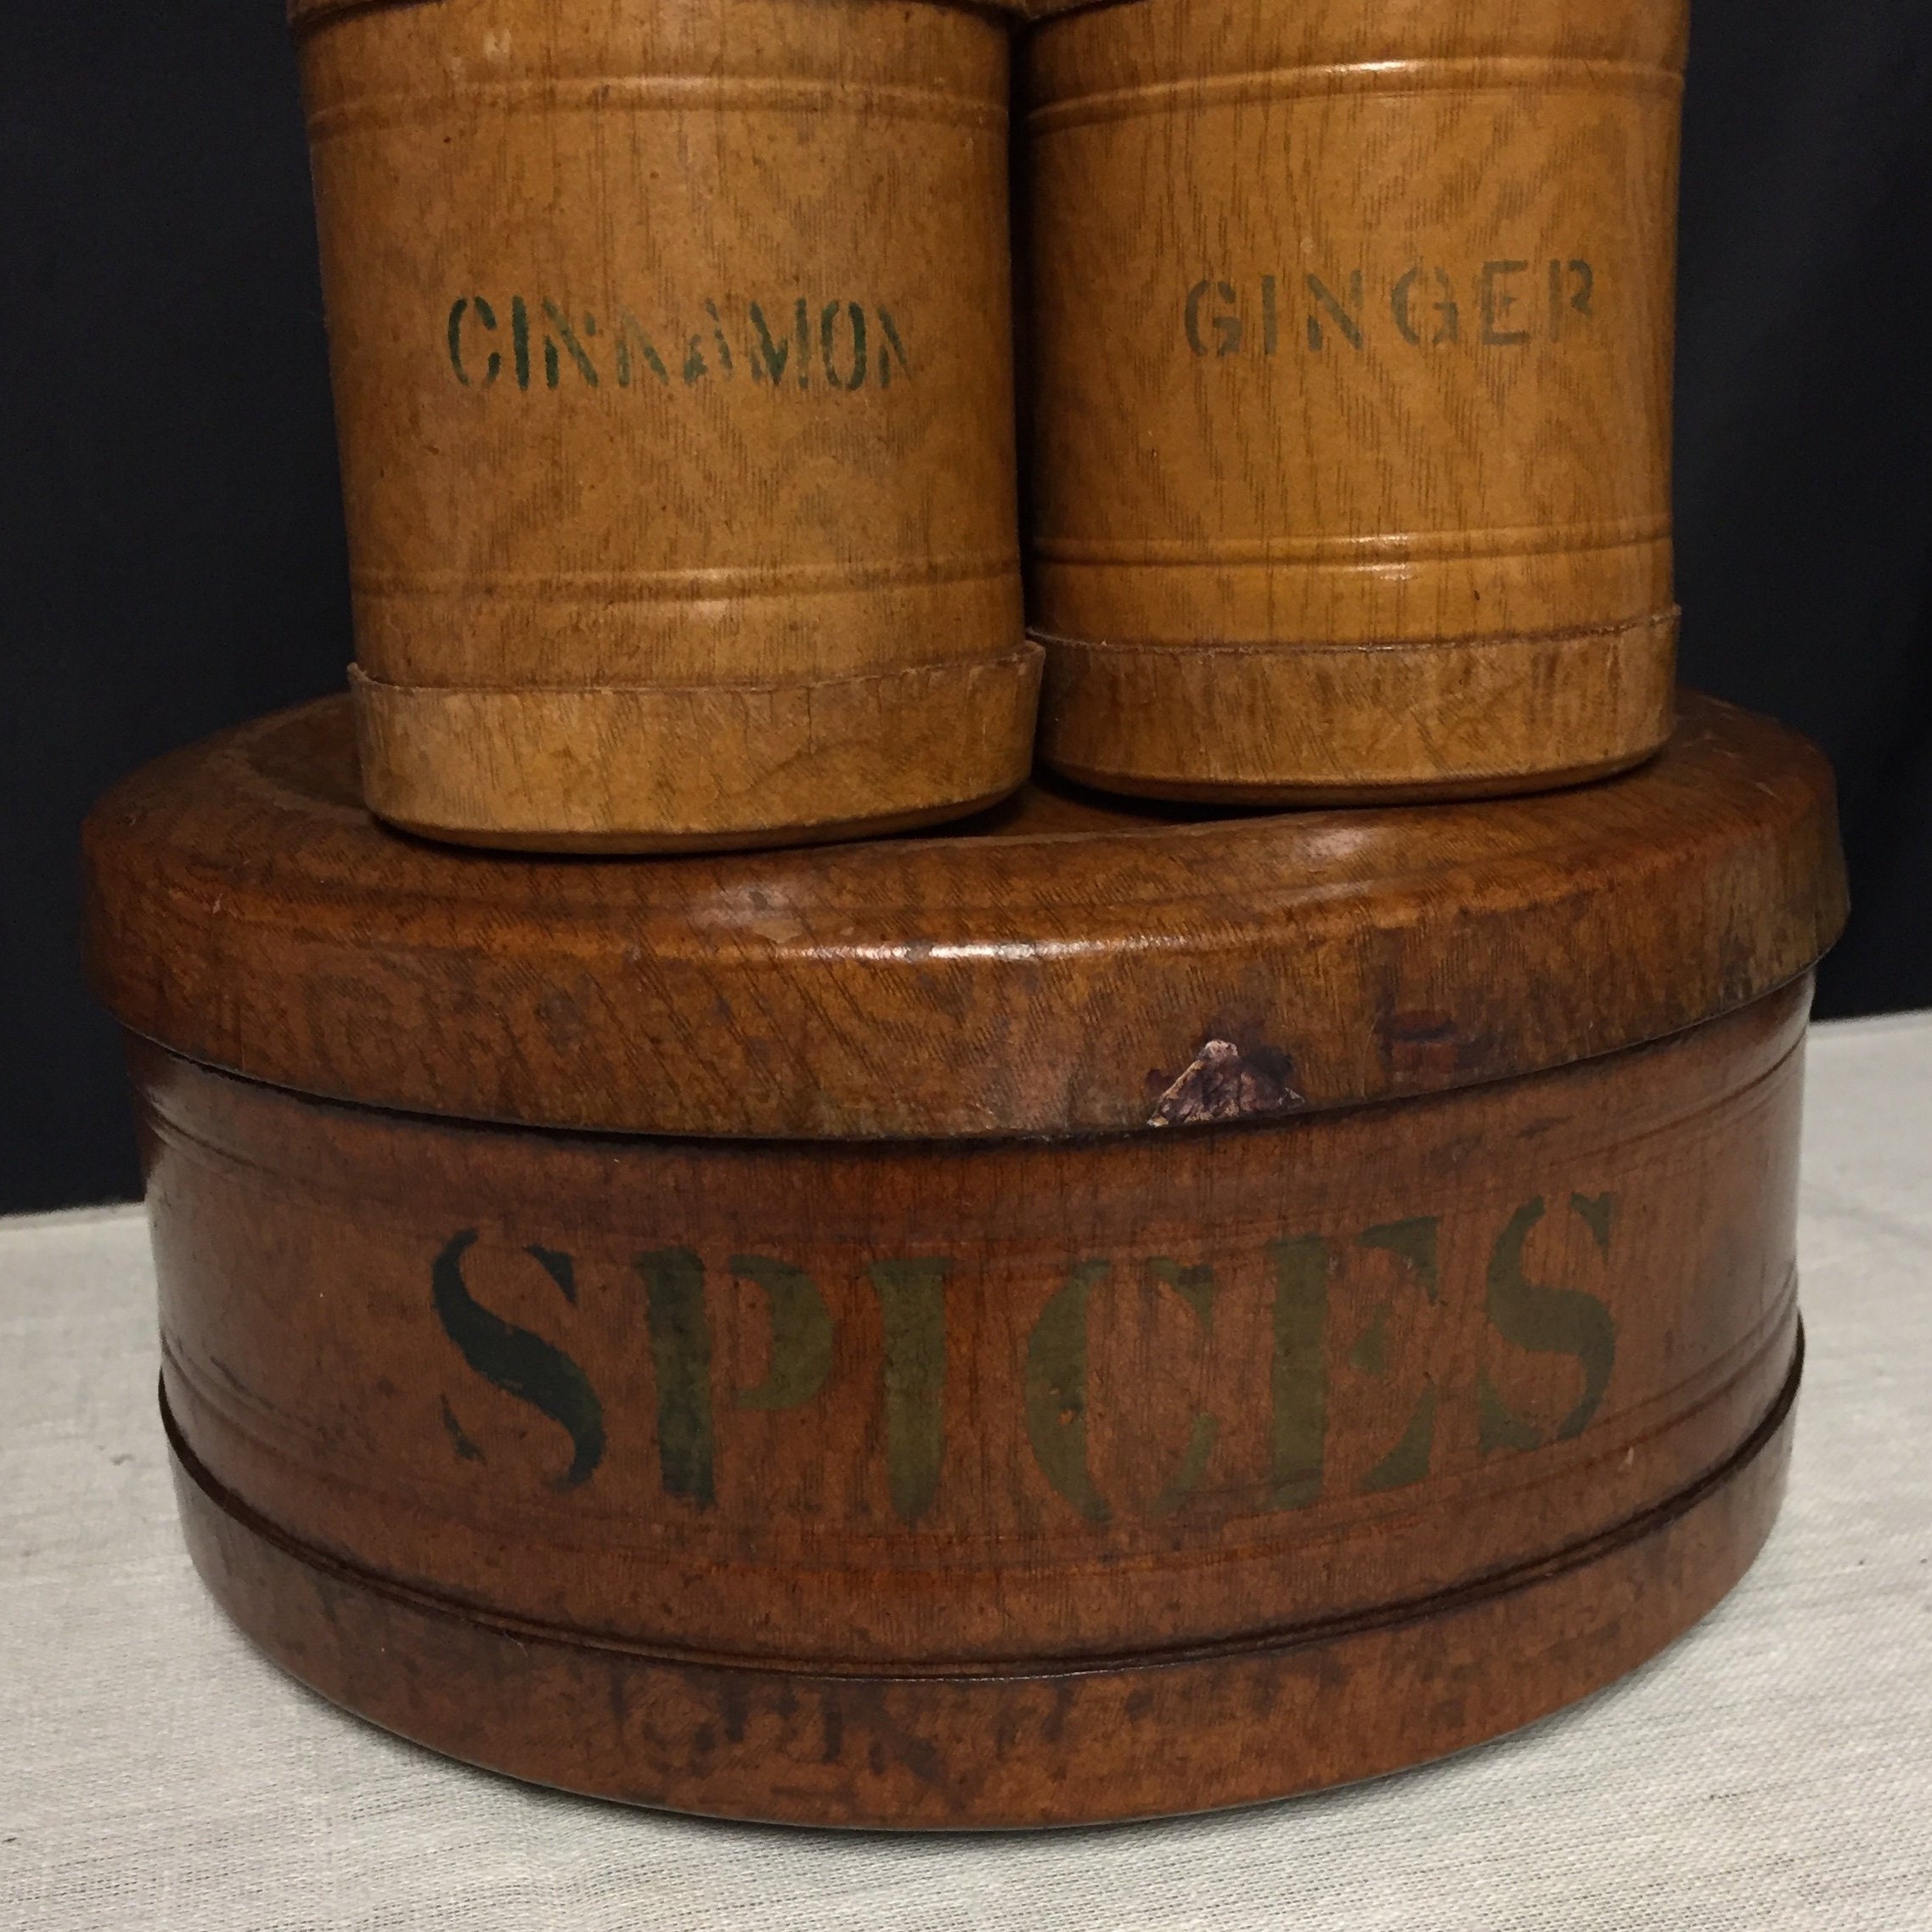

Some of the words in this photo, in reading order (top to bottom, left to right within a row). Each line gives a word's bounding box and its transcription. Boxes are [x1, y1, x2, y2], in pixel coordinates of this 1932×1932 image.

[447, 294, 914, 391] CINNAMON
[1184, 258, 1594, 358] GINGER
[431, 1191, 1616, 1525] SPICES
